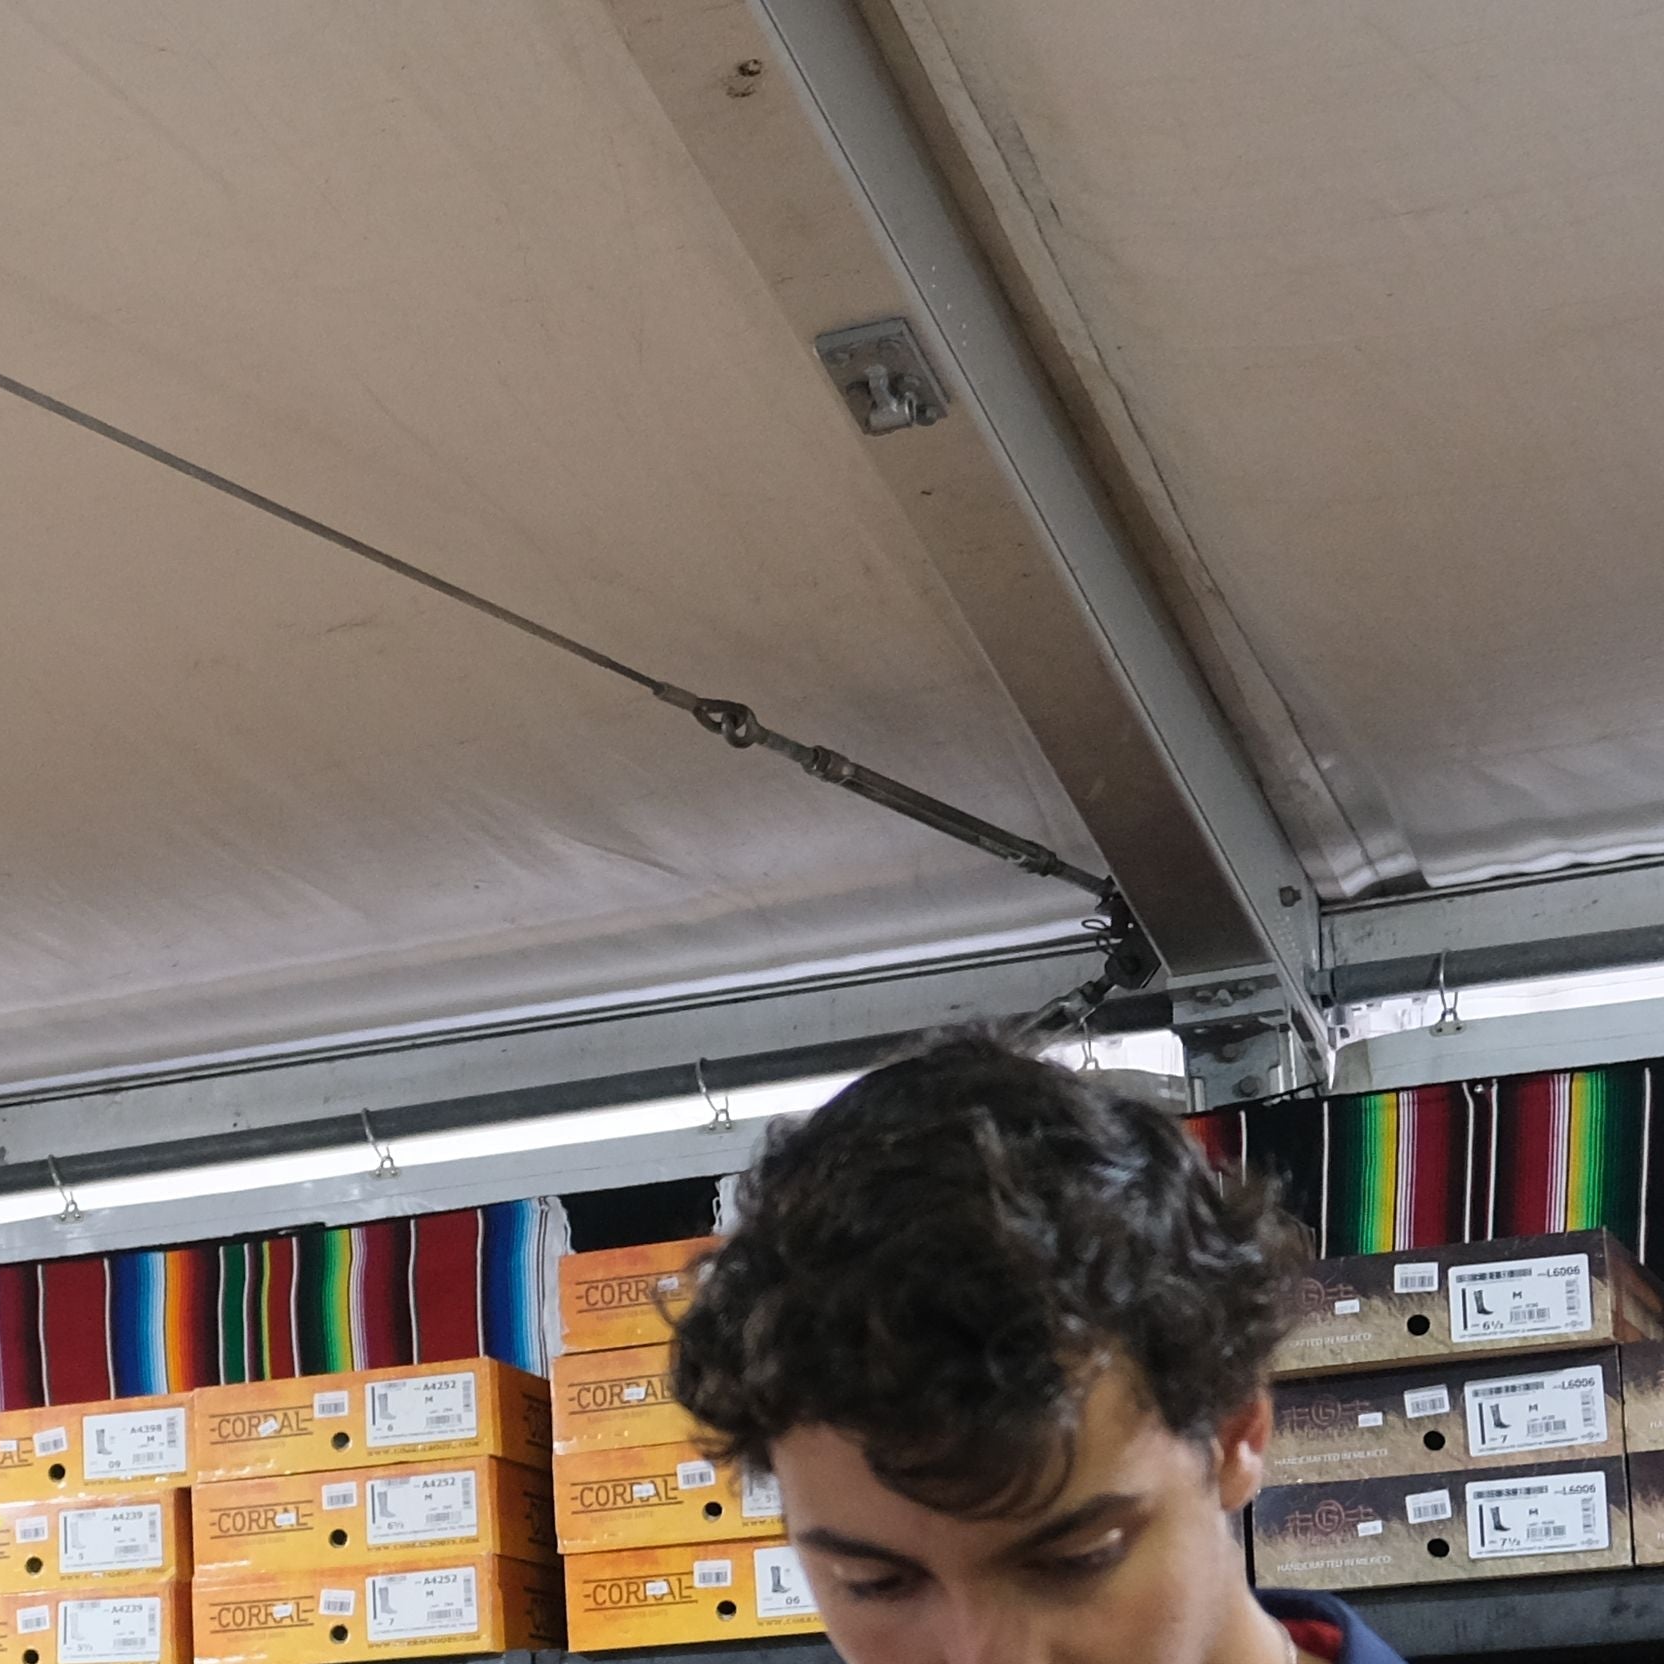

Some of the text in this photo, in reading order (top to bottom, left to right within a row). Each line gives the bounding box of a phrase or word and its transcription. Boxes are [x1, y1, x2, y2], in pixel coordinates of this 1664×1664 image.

[1546, 1266, 1580, 1277] L6006
[423, 1380, 457, 1391] A4252
[130, 1424, 162, 1434] A4398
[422, 1477, 456, 1489] A4252
[423, 1574, 458, 1586] A4252
